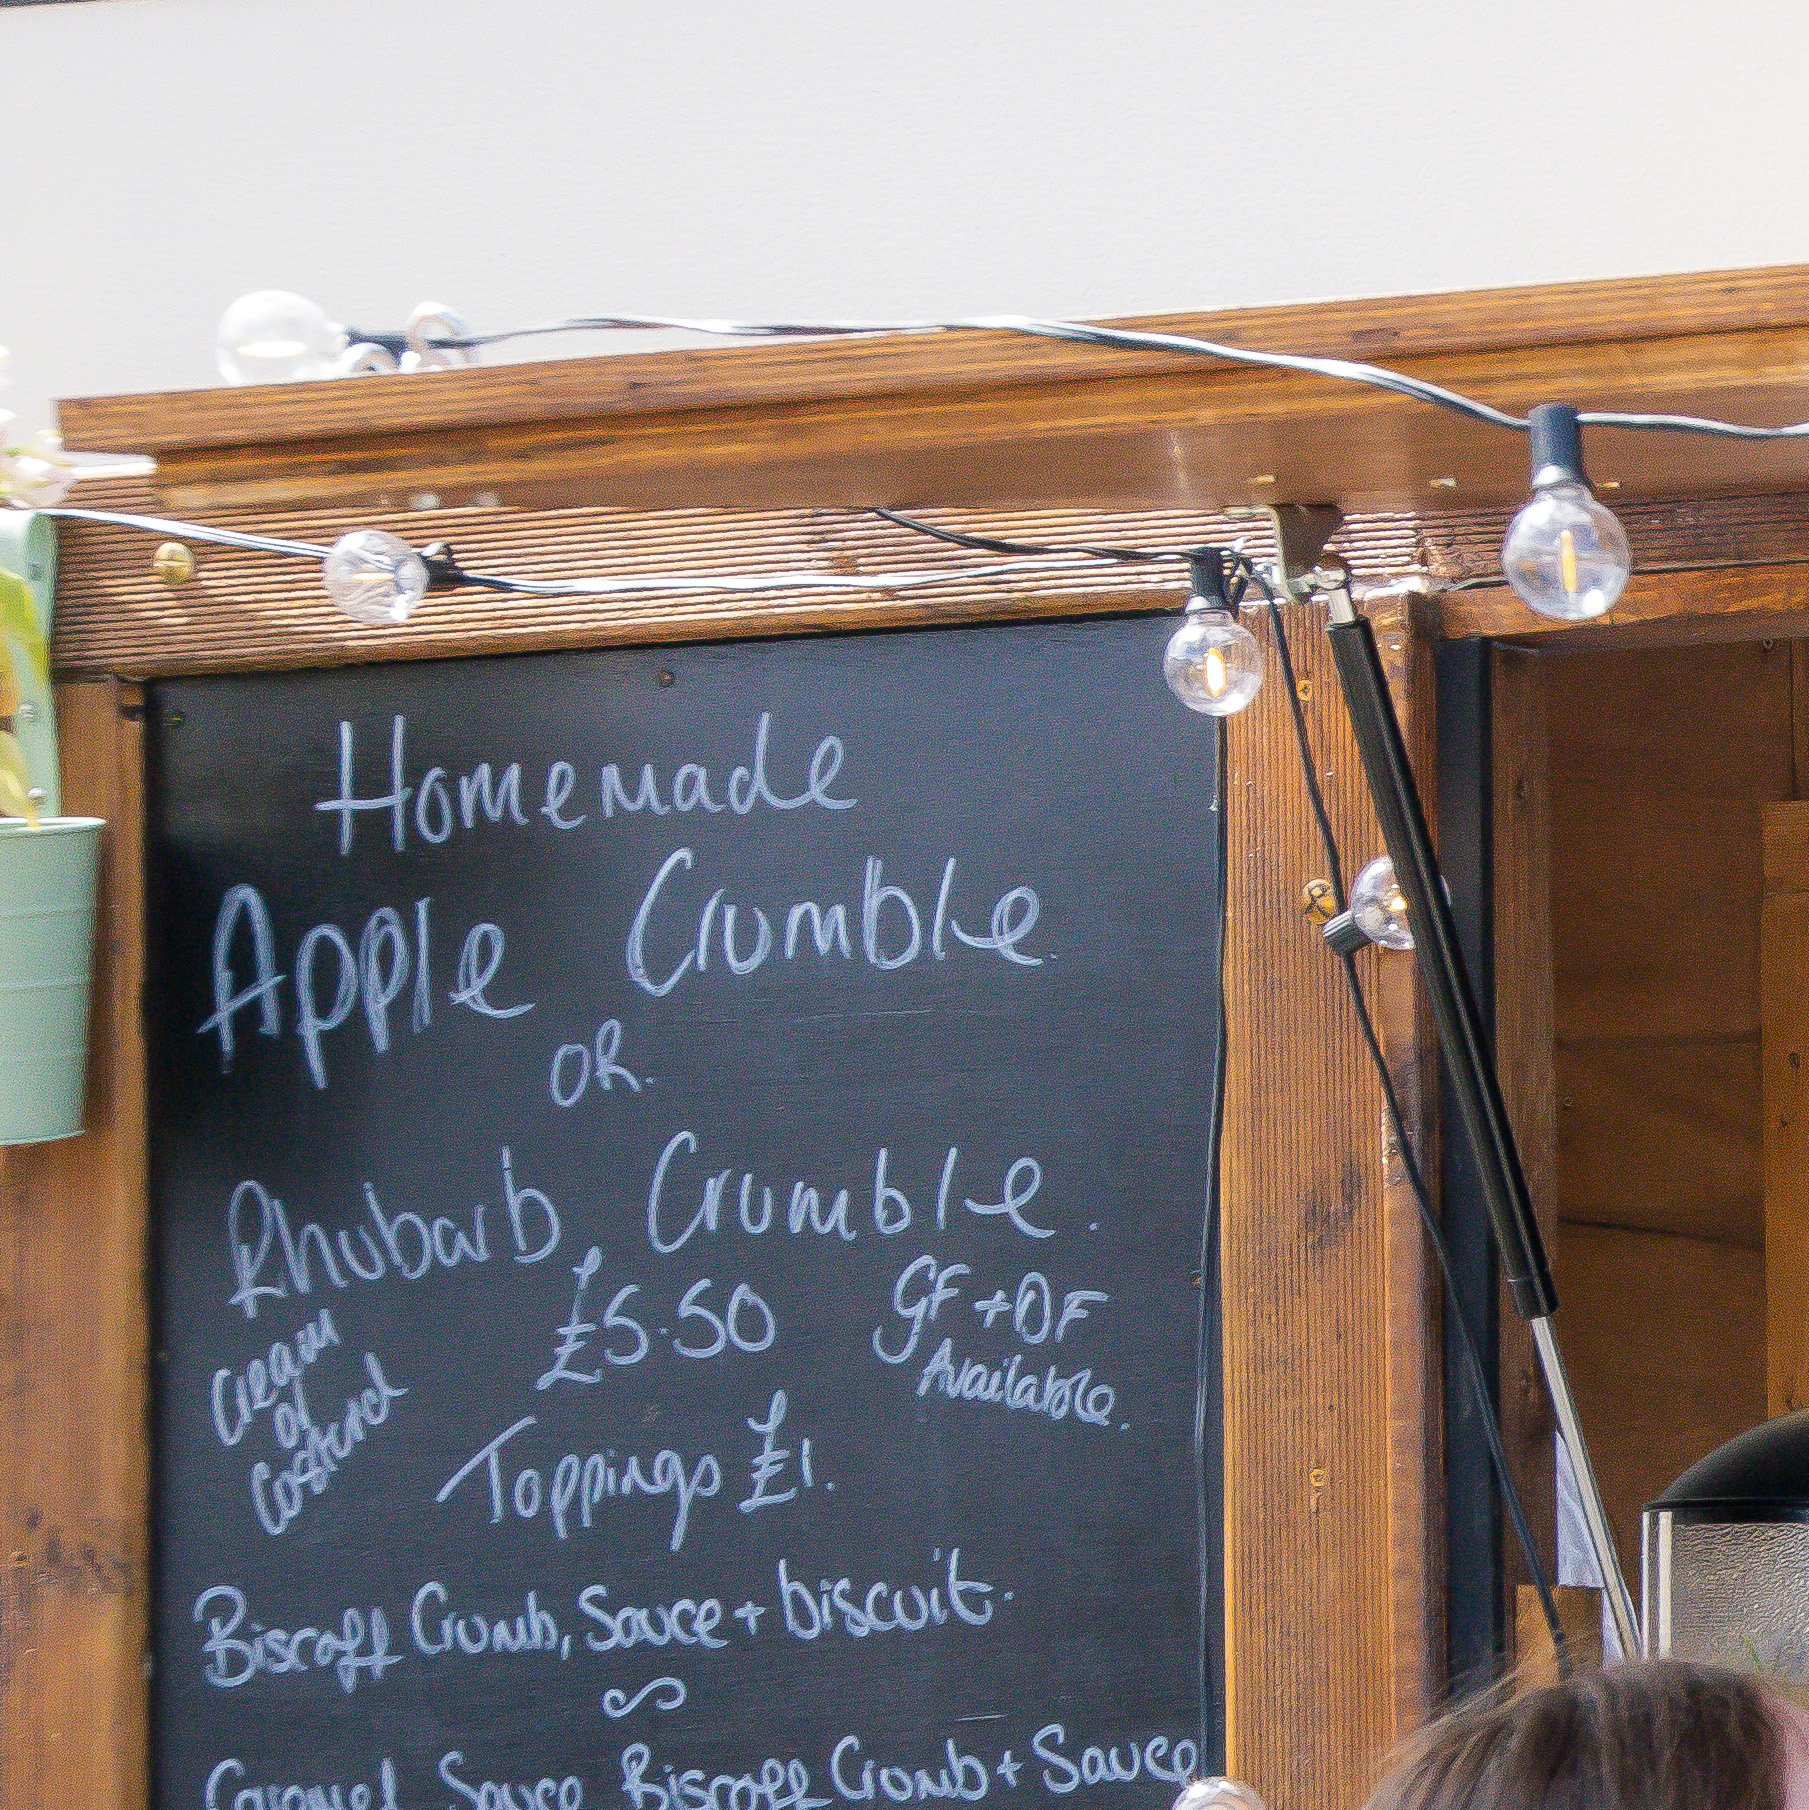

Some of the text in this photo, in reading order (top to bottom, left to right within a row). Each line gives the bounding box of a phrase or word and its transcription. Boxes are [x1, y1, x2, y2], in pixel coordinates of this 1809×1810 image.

[314, 711, 858, 856] Homemade
[197, 883, 537, 1090] Apple
[227, 1145, 560, 1320] Rhubarb
[872, 1254, 971, 1364] GF
[435, 1414, 722, 1552] Toppings
[194, 1585, 403, 1694] Biscoff
[579, 1583, 729, 1650] Sauce
[733, 1601, 767, 1636] +
[830, 1734, 990, 1802] Crumb
[1031, 1722, 1198, 1795] Sauce
